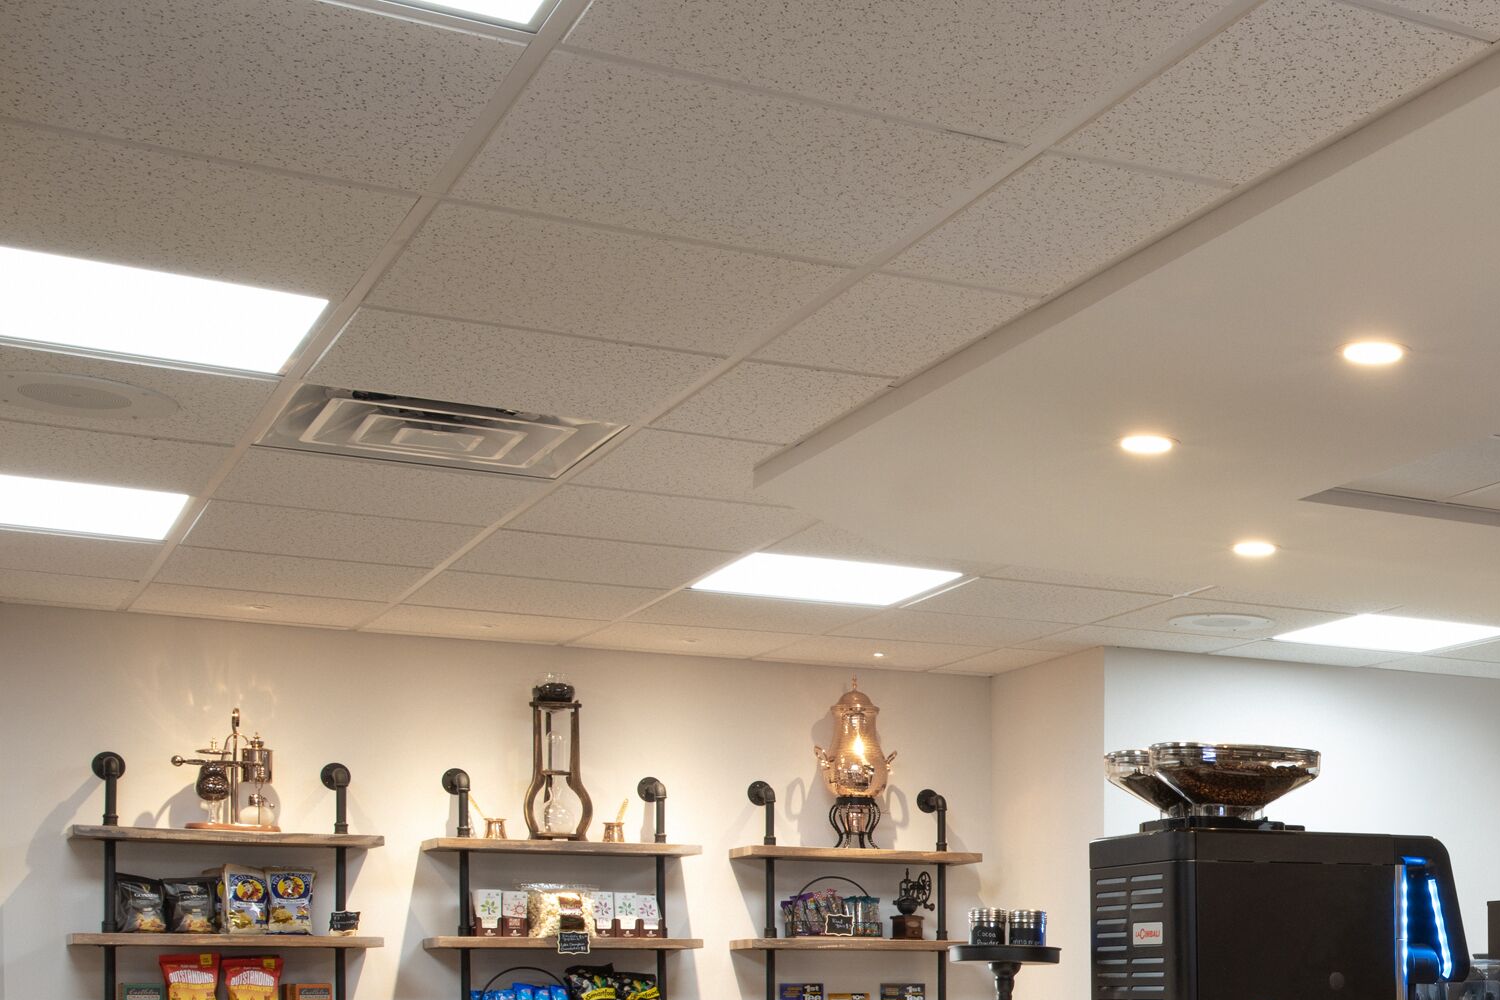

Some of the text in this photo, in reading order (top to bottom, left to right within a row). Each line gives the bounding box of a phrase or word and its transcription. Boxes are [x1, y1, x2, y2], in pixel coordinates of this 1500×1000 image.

[168, 969, 214, 984] OUTSTANDING
[230, 970, 275, 986] OUTSTANDING
[804, 985, 820, 993] 1st
